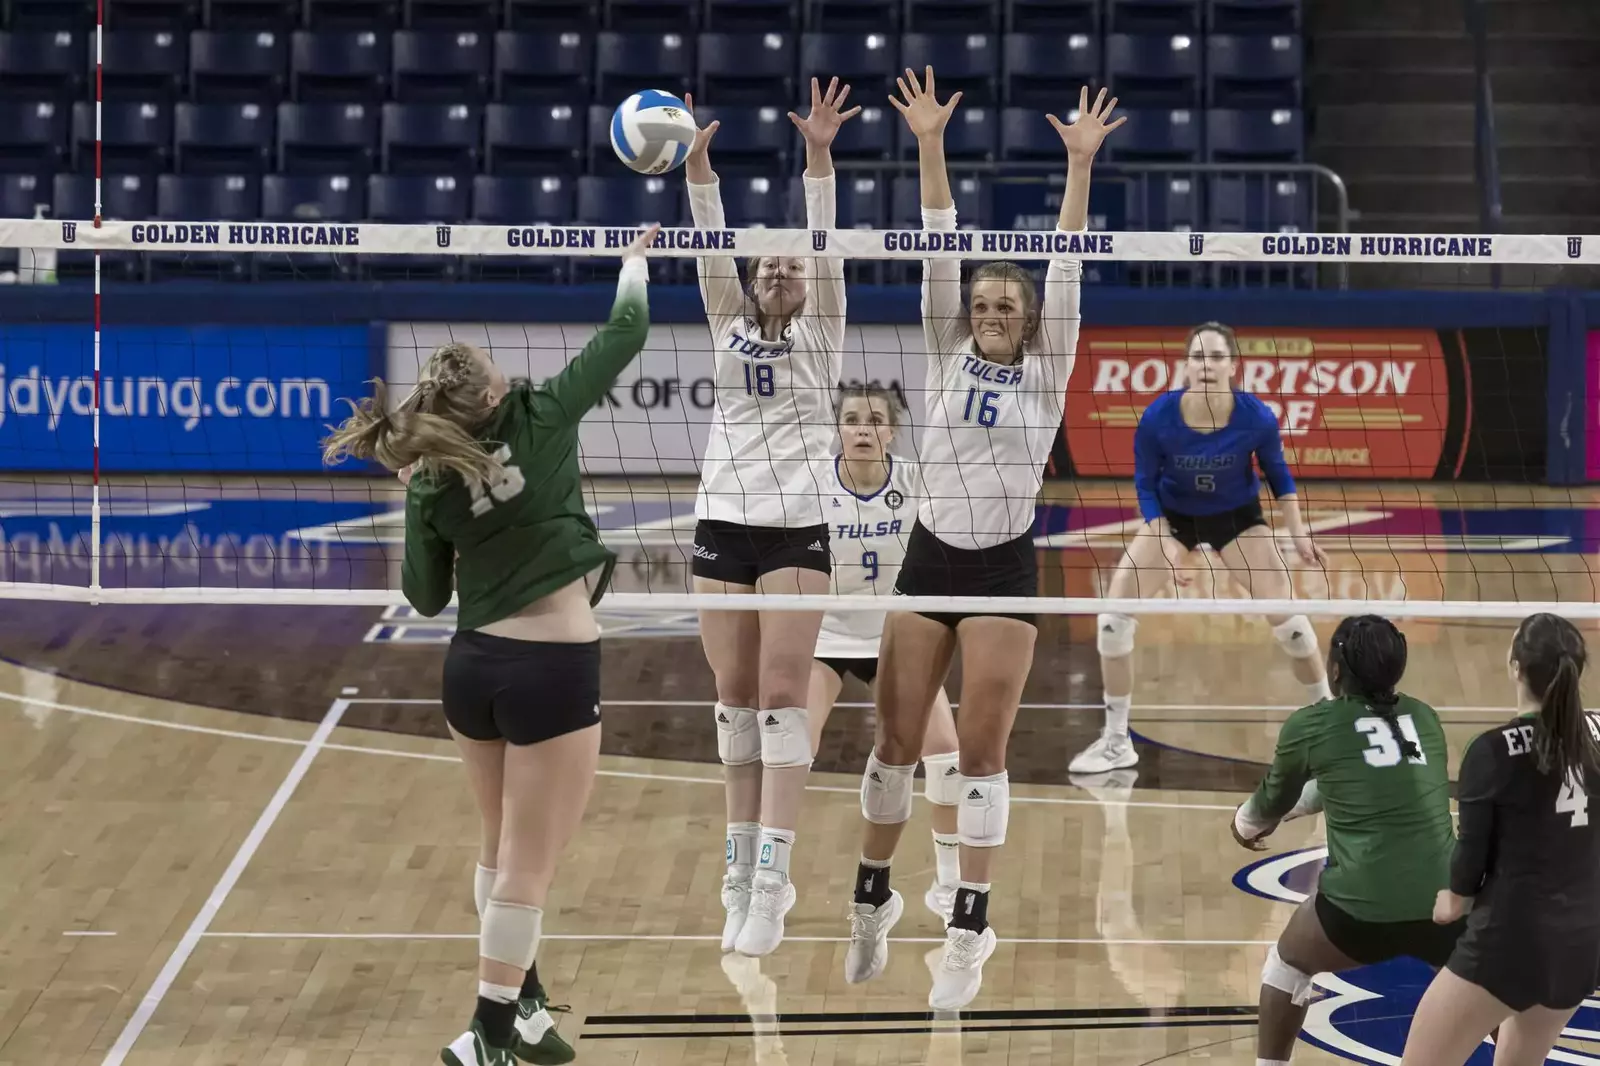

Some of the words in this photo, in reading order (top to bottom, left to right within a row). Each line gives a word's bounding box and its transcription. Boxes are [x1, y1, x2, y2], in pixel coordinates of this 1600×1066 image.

[131, 224, 219, 243] GOLDEN
[228, 225, 360, 245] HURRICANE
[507, 228, 596, 248] GOLDEN
[604, 229, 736, 249] HURICANE
[884, 232, 973, 252] GOLDEN
[982, 233, 1114, 253] HURRICANE
[1262, 236, 1351, 255] GOLDEN
[1360, 237, 1492, 257] HURRICANE
[728, 333, 795, 359] TULSA
[743, 361, 776, 398] 18
[962, 355, 1024, 386] TULSA
[1092, 358, 1417, 396] RORTSON
[631, 377, 682, 408] OF
[962, 386, 1001, 428] 16
[1174, 454, 1236, 470] TULSA
[1195, 474, 1215, 492] 5
[837, 520, 902, 539] TULSA
[862, 551, 878, 580] 9
[1354, 714, 1427, 768] 31
[1556, 764, 1588, 827] 4
